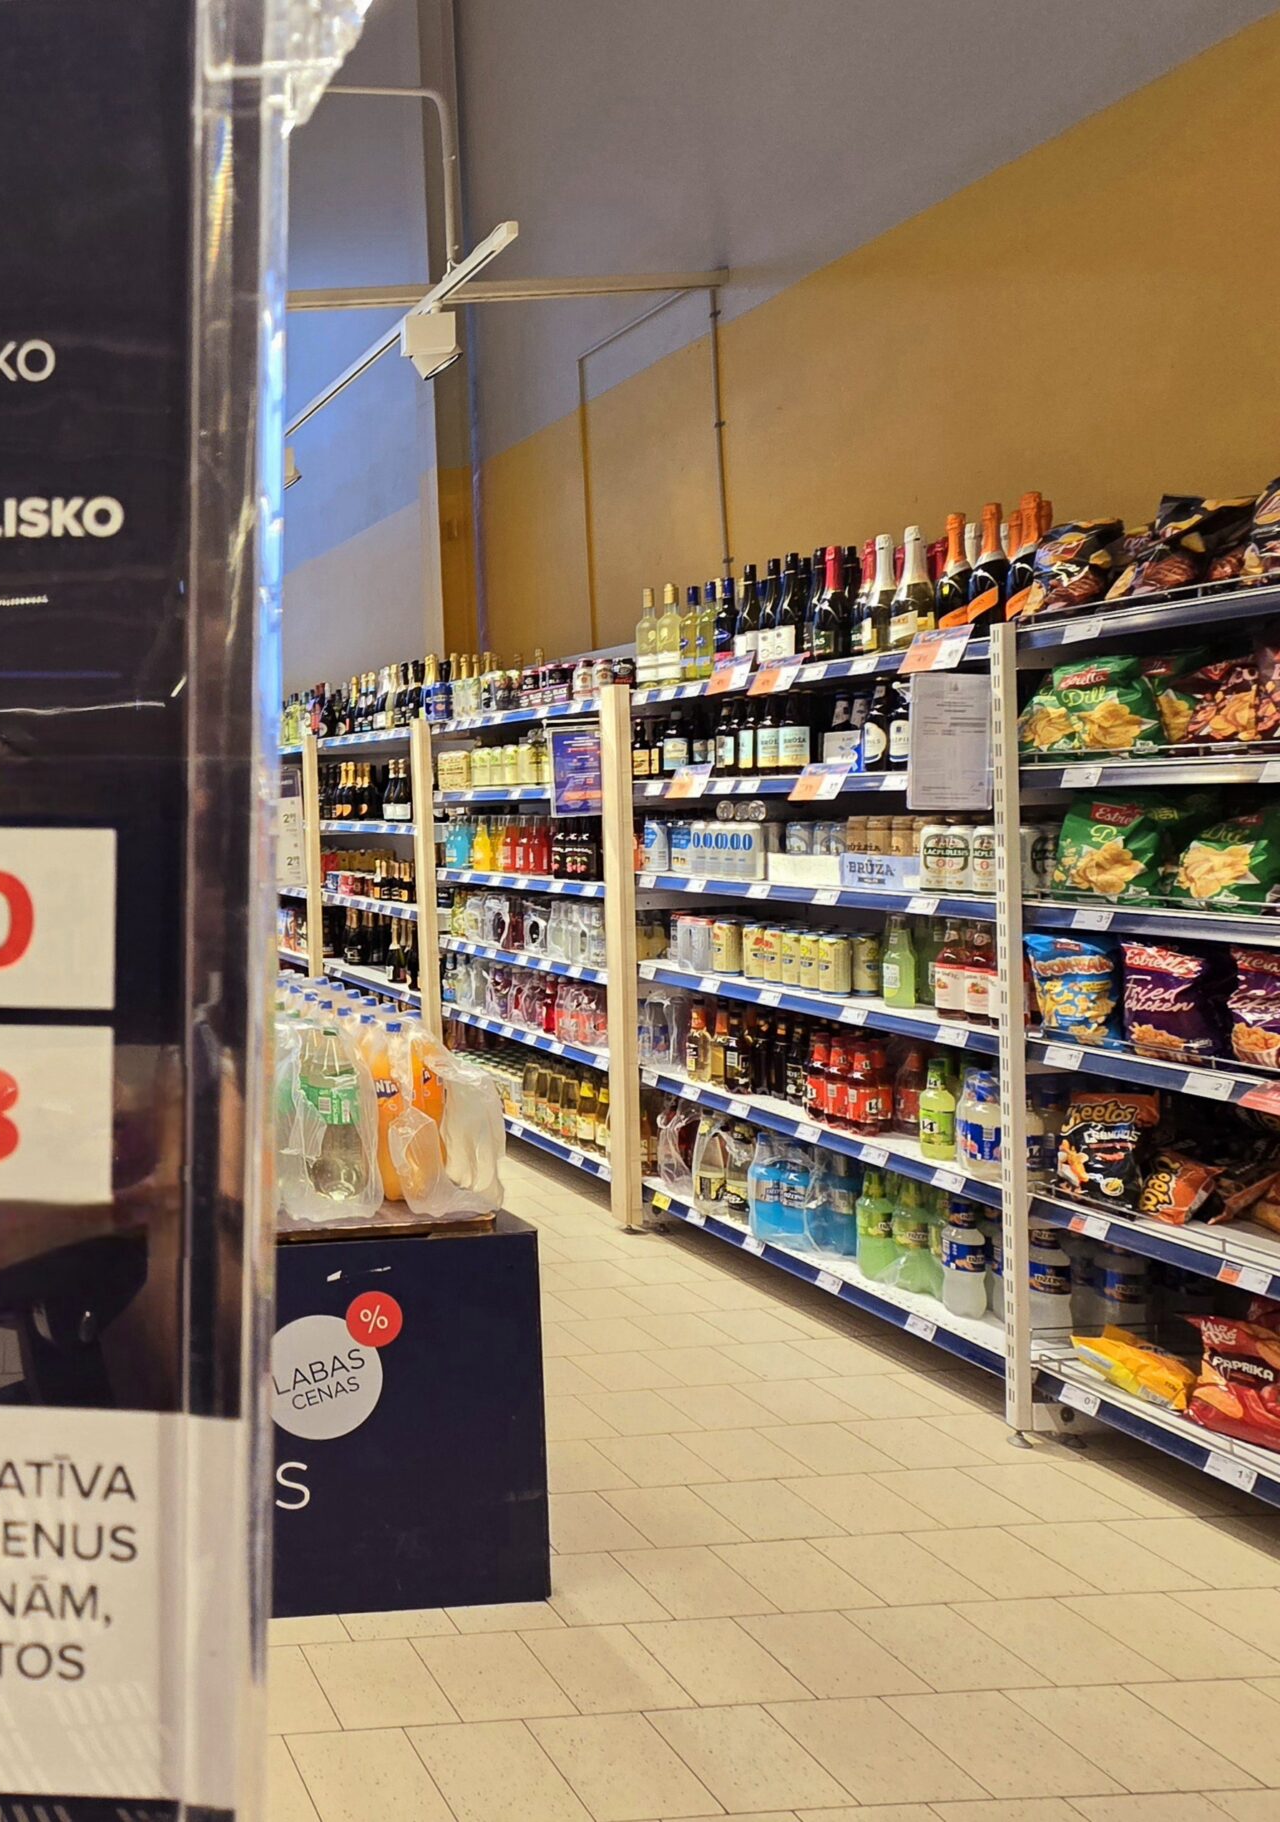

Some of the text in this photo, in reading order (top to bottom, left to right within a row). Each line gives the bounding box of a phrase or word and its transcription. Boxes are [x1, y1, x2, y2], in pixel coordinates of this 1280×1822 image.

[272, 1347, 366, 1396] LABAS
[1211, 1355, 1275, 1382] PAPRIKA
[291, 1375, 361, 1411] CENAS
